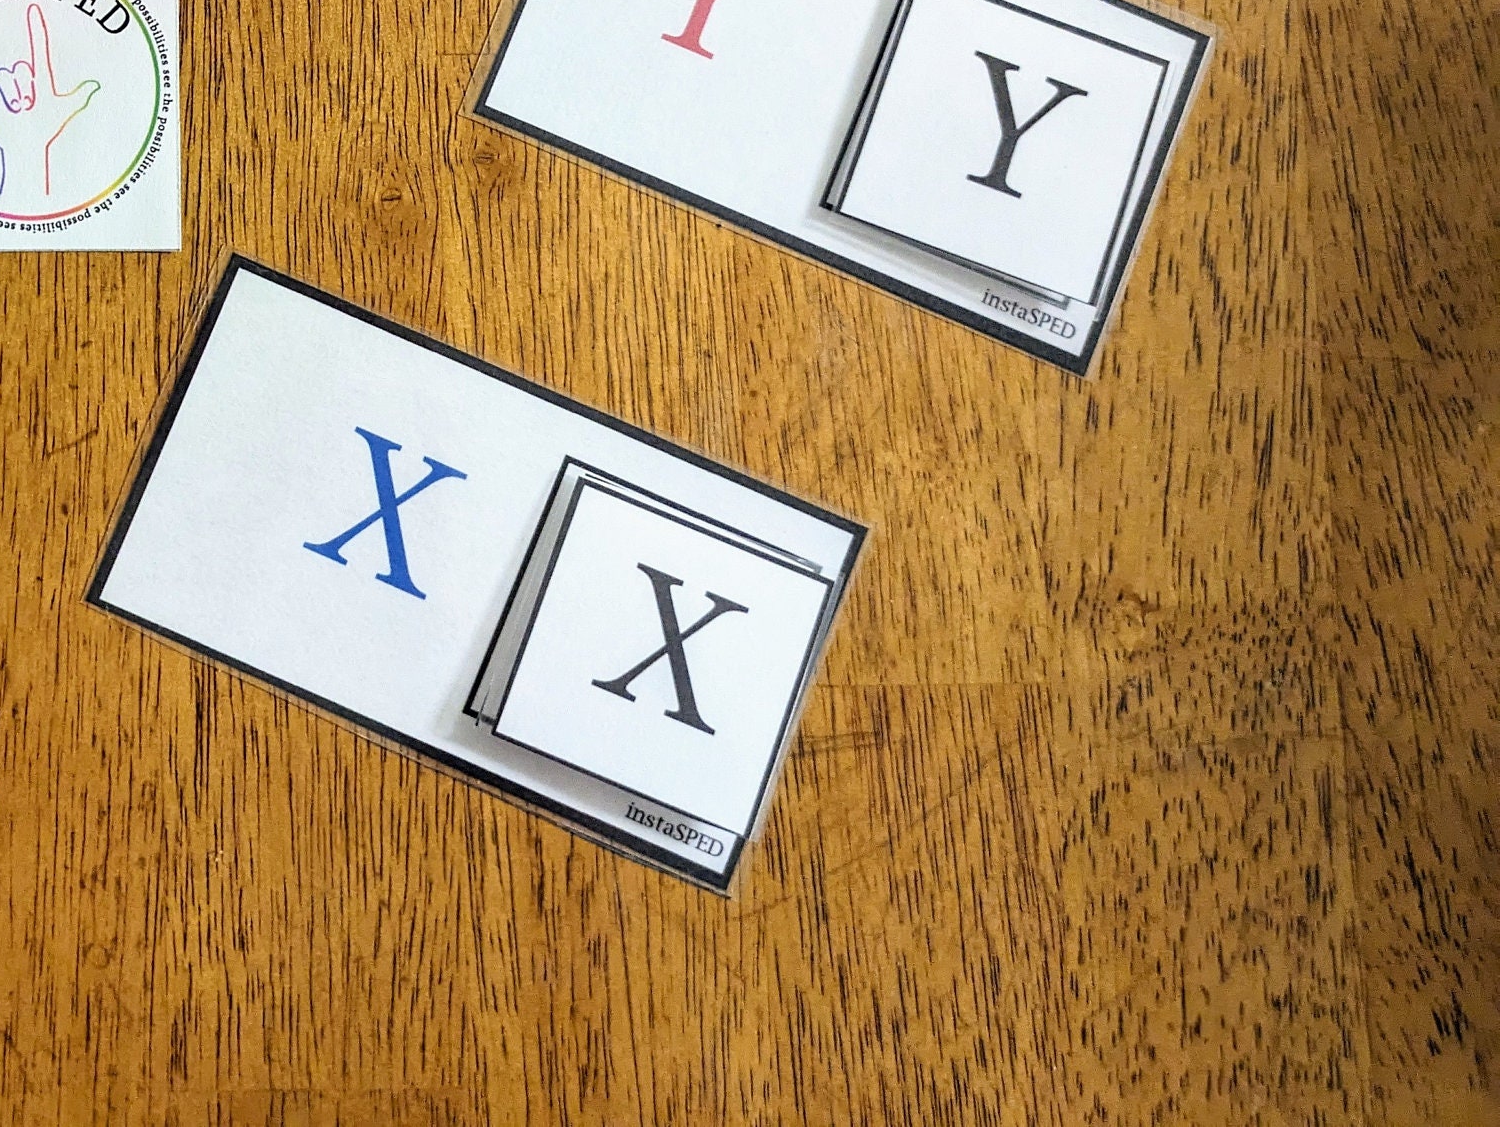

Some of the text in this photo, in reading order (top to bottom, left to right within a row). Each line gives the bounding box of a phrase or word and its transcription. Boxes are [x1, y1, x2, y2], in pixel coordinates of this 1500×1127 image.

[162, 94, 173, 112] the
[969, 52, 1087, 198] Y
[130, 117, 167, 182] possibilities
[95, 199, 112, 213] the
[114, 184, 129, 198] see
[21, 208, 91, 233] possibilities
[980, 288, 1077, 339] instaSPED
[303, 427, 467, 599] X
[592, 564, 748, 735] X
[625, 802, 725, 857] instaSPED
